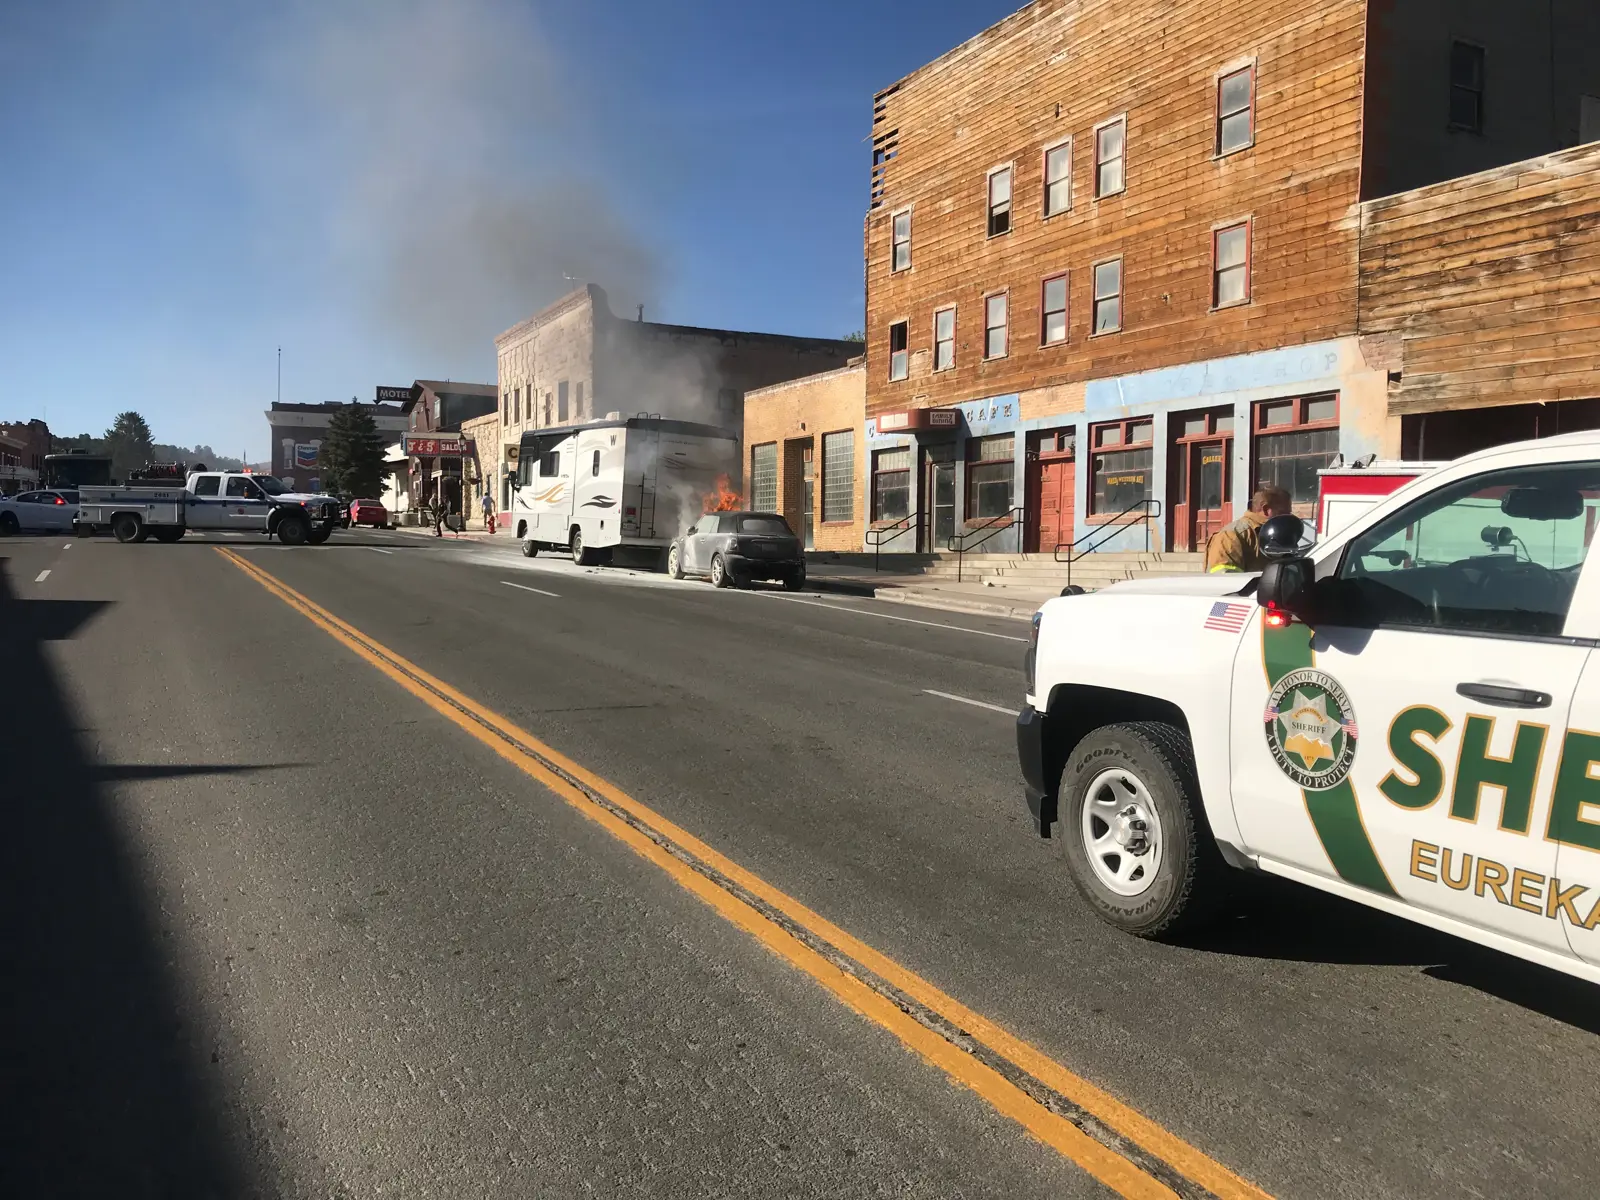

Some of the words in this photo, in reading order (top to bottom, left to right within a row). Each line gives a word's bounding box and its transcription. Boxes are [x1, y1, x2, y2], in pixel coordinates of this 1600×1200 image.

[380, 390, 411, 399] MOTEL
[1281, 672, 1313, 688] HONOR
[1315, 673, 1328, 685] TO
[1330, 683, 1352, 717] SERVE
[1291, 721, 1327, 734] SHERIFF
[1076, 748, 1151, 783] GOODYEA
[1266, 733, 1274, 741] A
[1271, 745, 1295, 777] DUTY
[1296, 771, 1312, 787] TO
[1315, 746, 1355, 788] PROTECT
